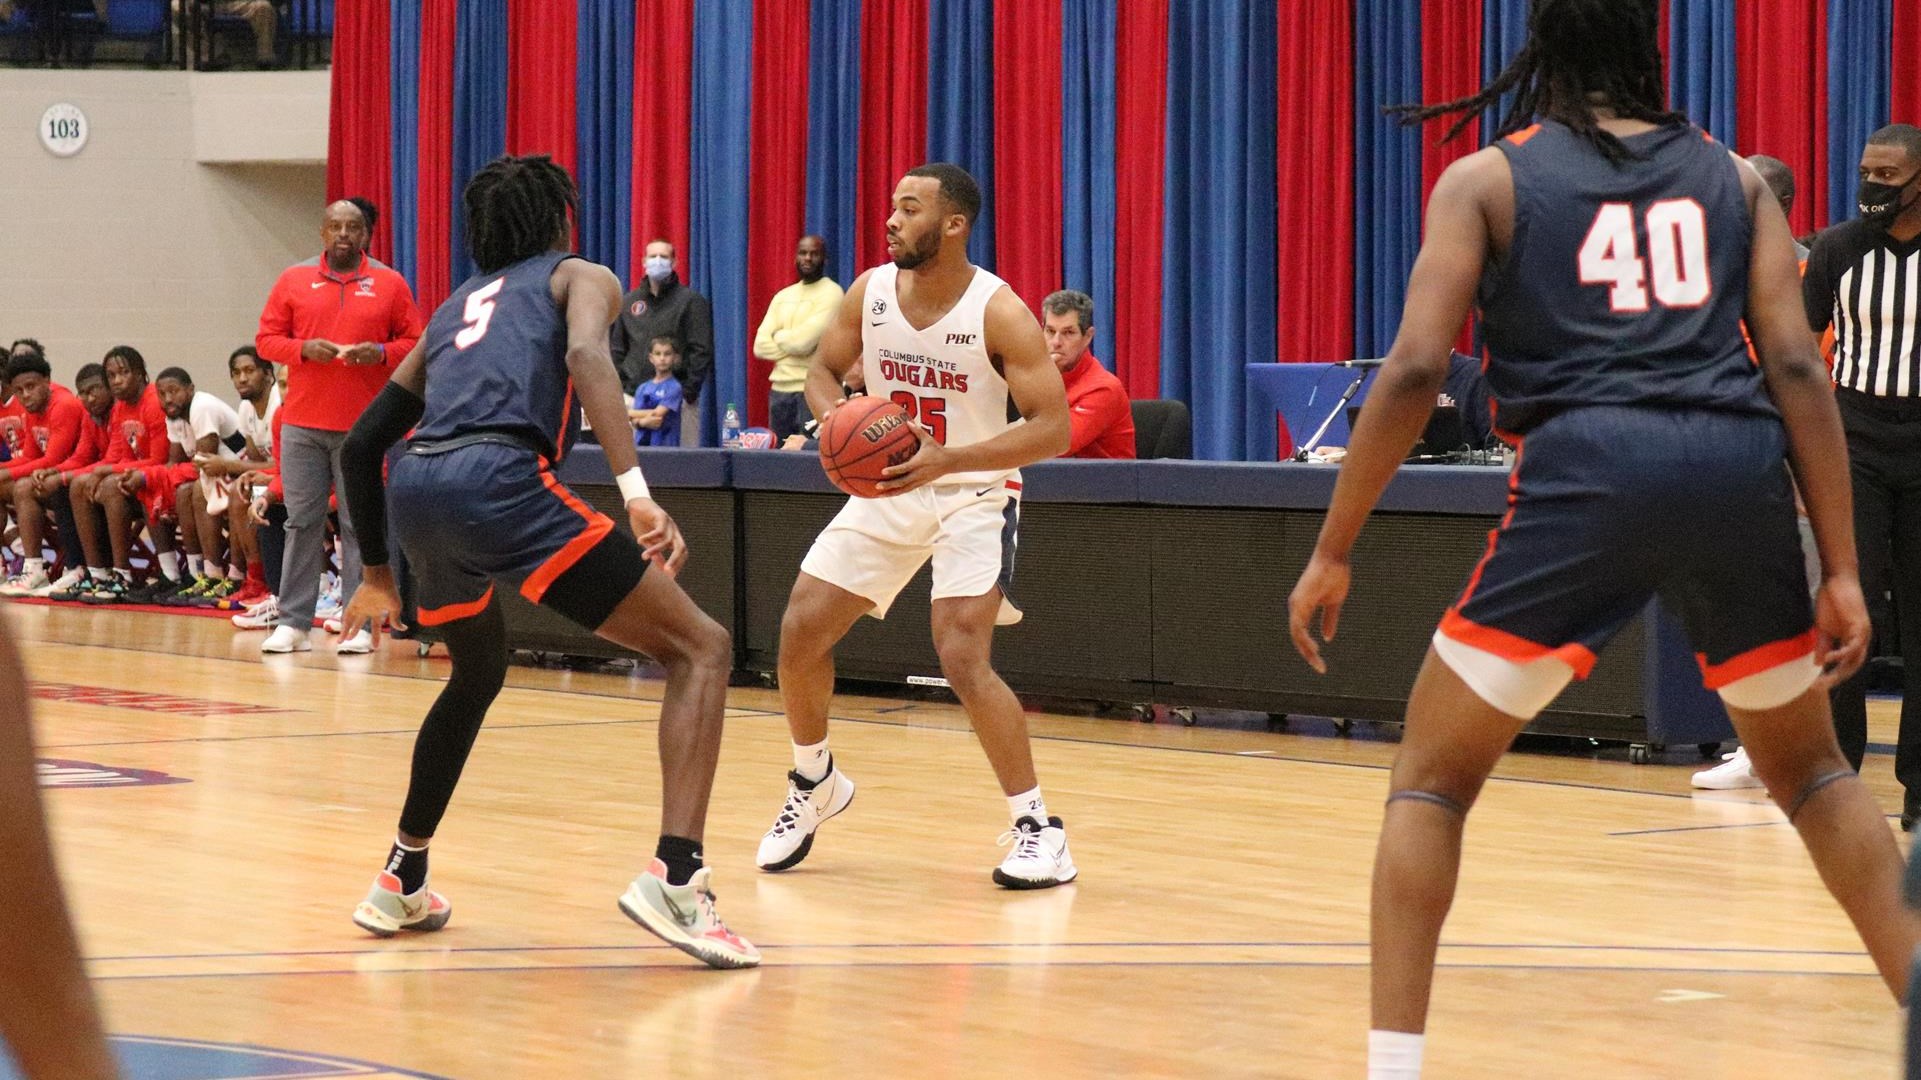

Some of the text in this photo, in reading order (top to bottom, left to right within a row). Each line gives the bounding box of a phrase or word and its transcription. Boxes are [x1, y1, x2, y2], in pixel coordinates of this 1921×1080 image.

[49, 118, 80, 139] 103
[1577, 197, 1713, 314] 40
[454, 275, 506, 351] 5
[872, 301, 884, 312] 24
[945, 333, 976, 345] PBC
[879, 348, 956, 371] COLUMBUS STATE
[880, 359, 968, 393] OUGARS
